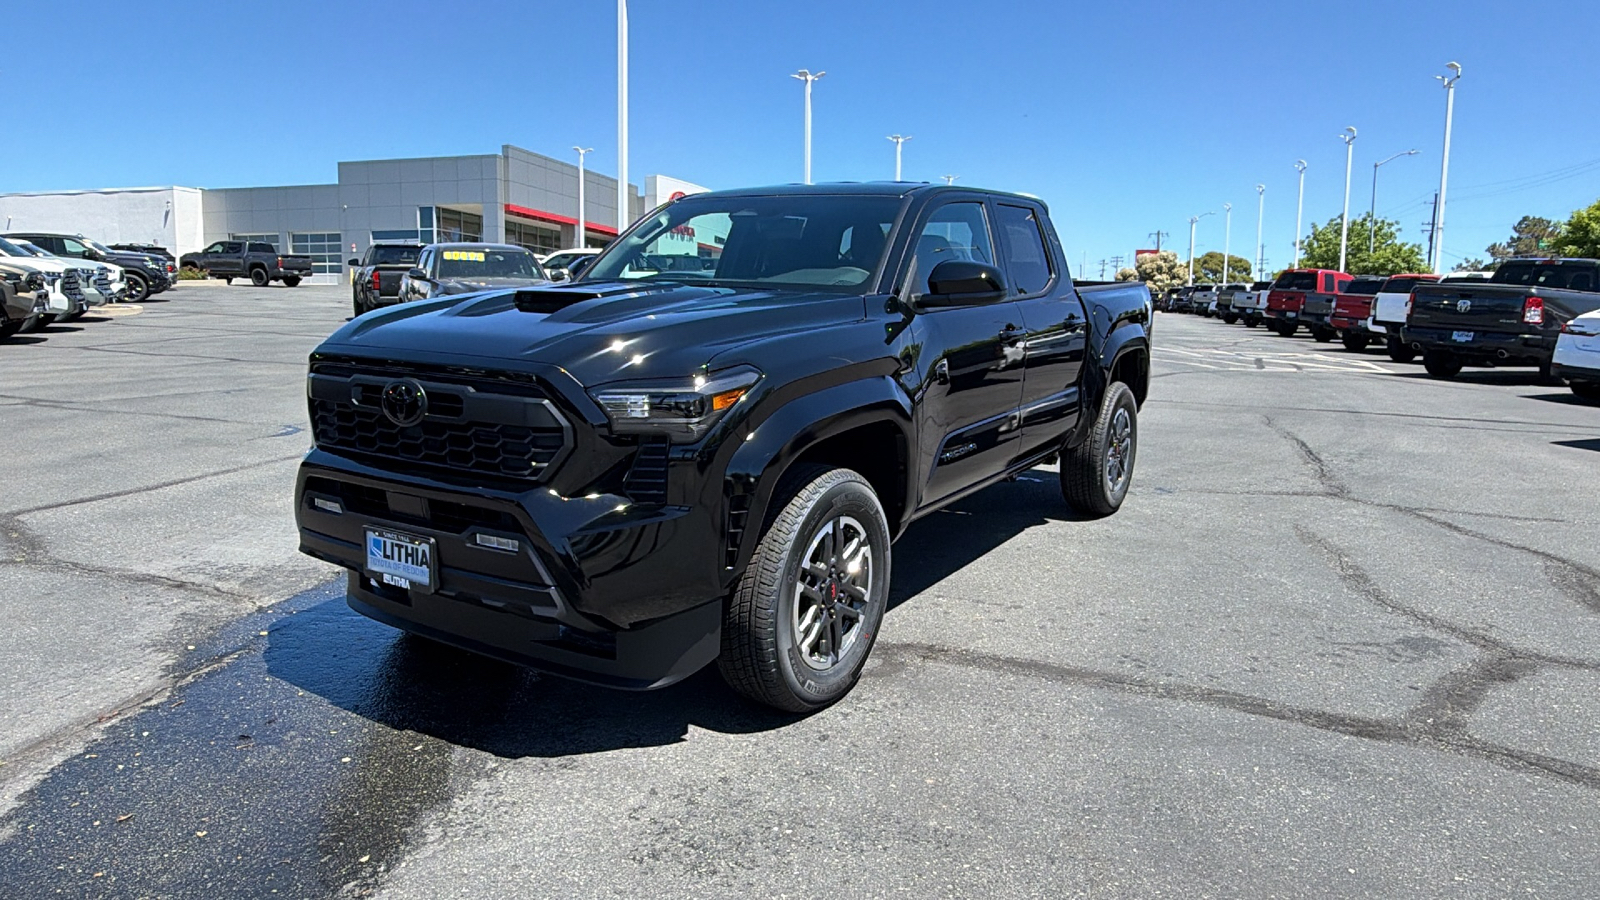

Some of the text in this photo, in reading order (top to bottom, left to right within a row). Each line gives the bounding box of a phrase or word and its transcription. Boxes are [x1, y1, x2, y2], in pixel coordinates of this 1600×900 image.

[383, 532, 397, 541] SINCE
[383, 540, 429, 569] LITHIA
[369, 557, 429, 578] TOYOTA OF REDDIN
[390, 575, 411, 590] LITHIA
